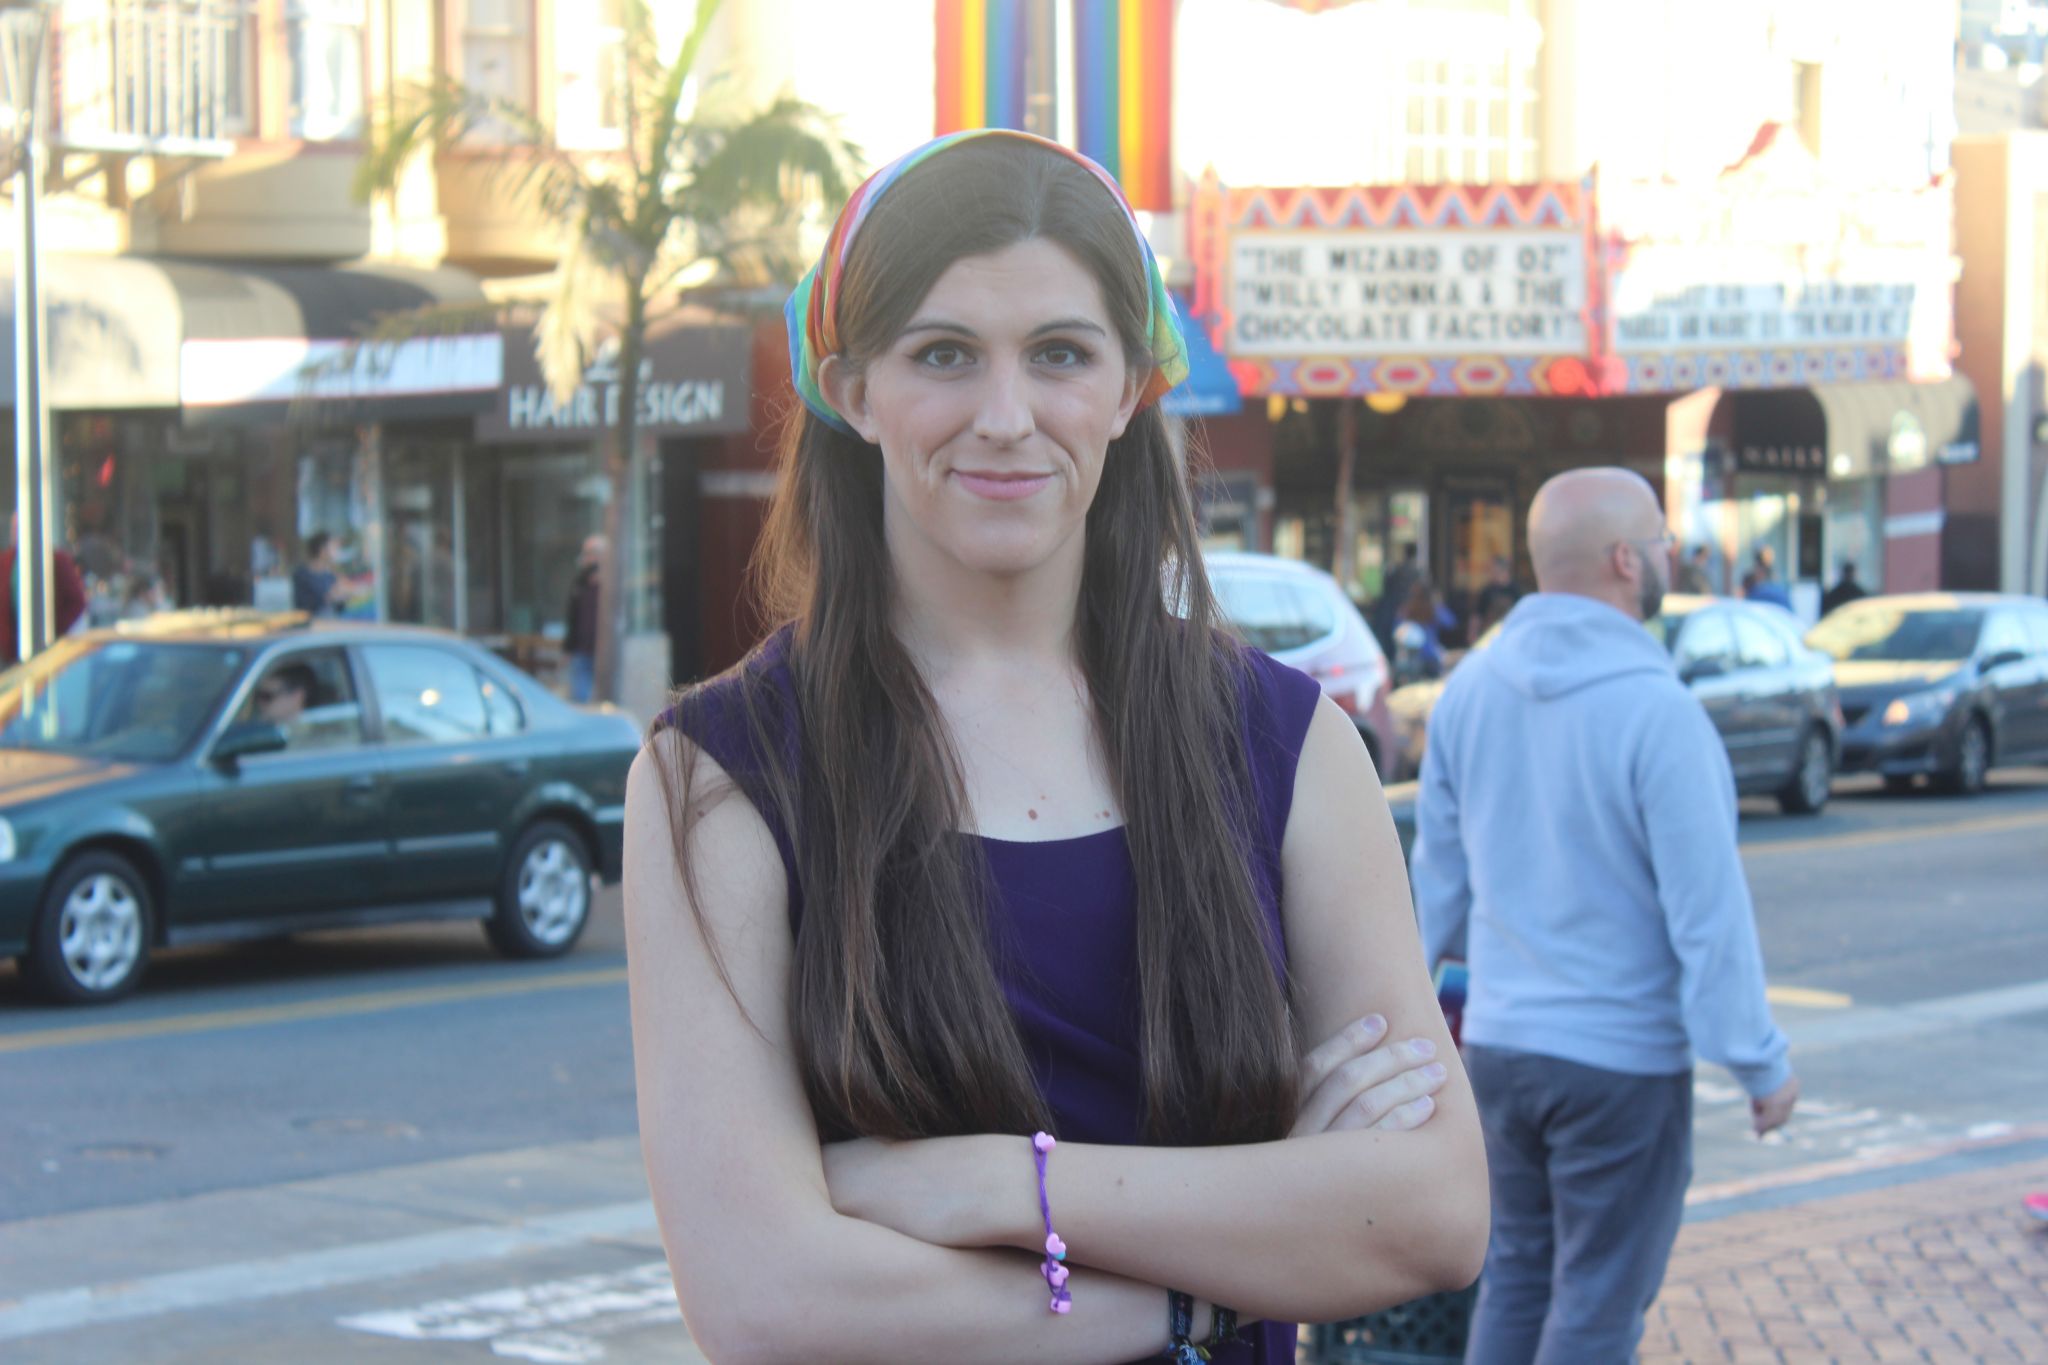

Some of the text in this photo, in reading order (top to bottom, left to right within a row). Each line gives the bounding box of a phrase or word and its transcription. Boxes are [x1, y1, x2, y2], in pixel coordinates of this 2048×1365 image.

[1329, 244, 1441, 273] WIZARD
[1462, 244, 1498, 273] OF
[1362, 280, 1465, 307] WONKA
[1516, 276, 1566, 307] THE
[1236, 311, 1411, 342] CHOCOLATE
